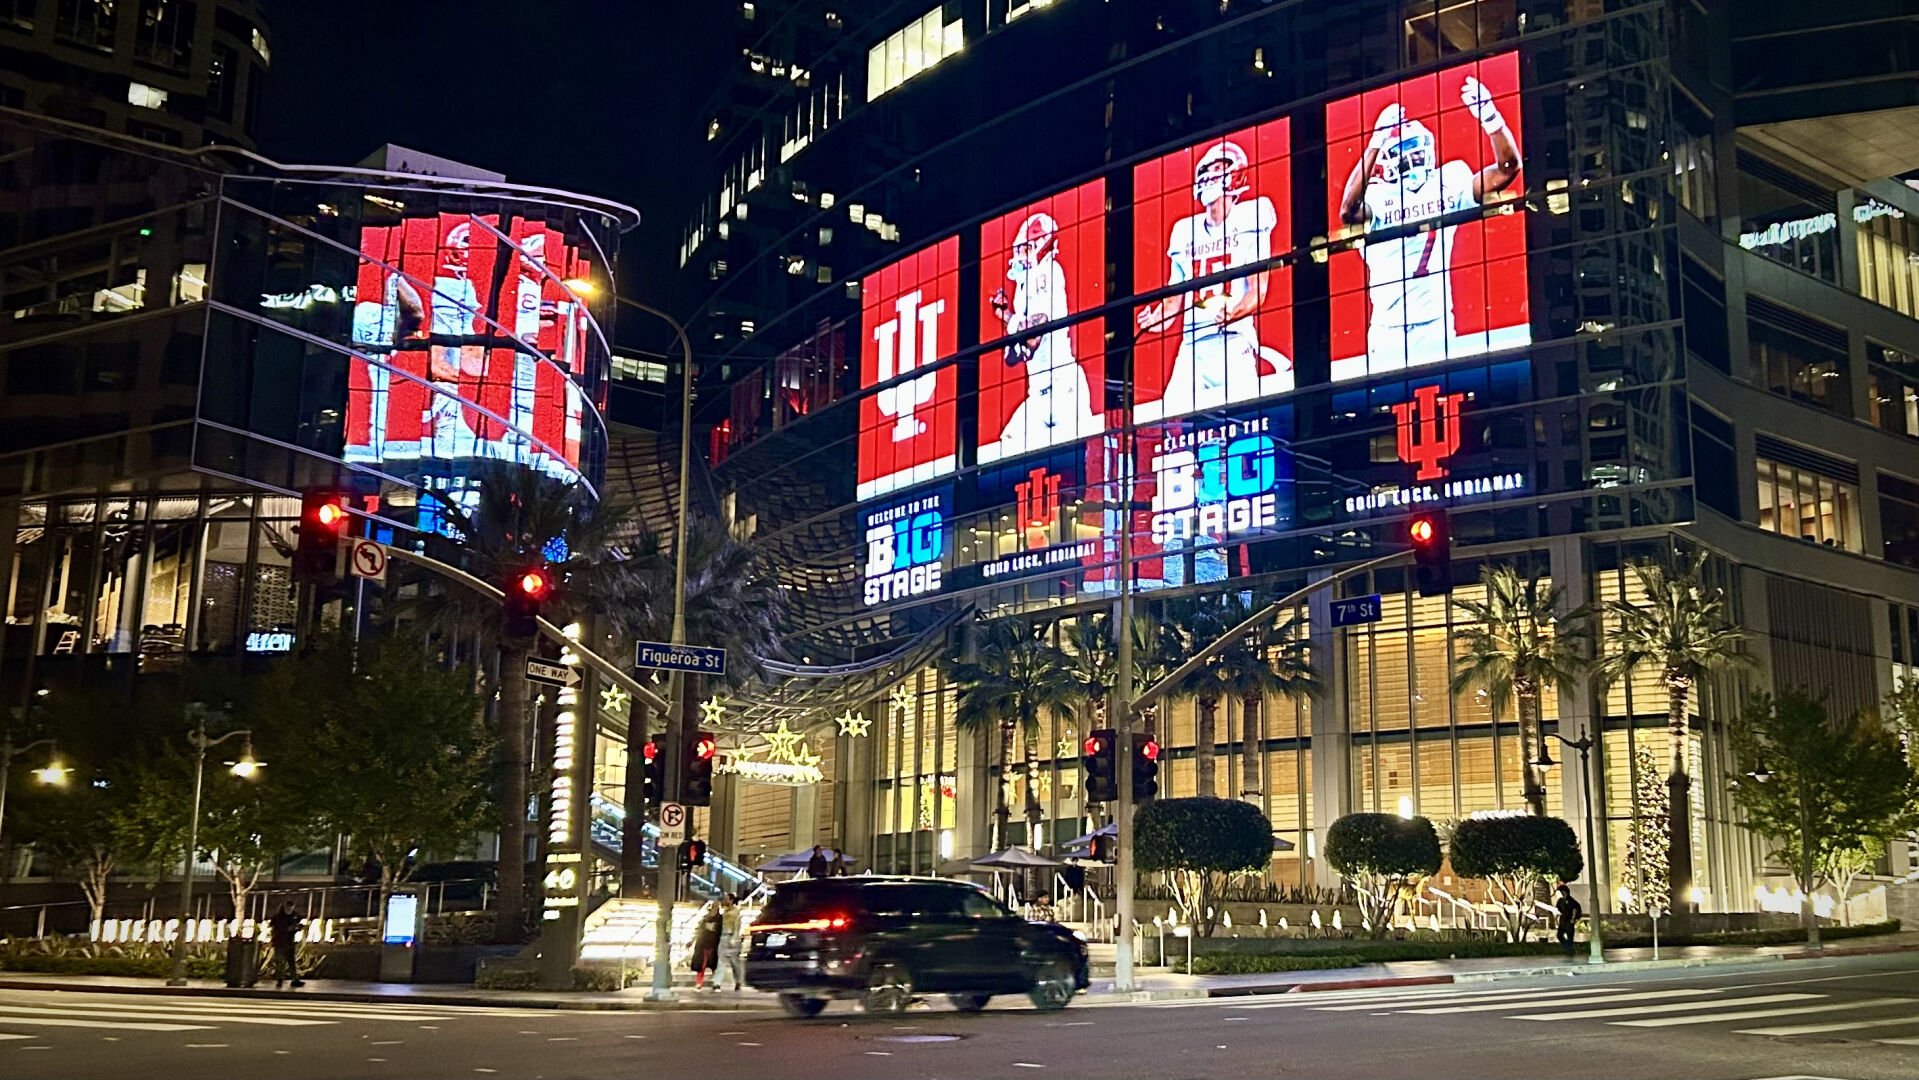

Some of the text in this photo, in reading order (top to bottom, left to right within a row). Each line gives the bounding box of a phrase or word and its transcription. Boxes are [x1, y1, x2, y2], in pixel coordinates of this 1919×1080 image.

[1219, 423, 1237, 439] TO
[1243, 417, 1269, 434] THE
[1346, 493, 1387, 513] GOOD
[1444, 473, 1522, 498] INDIANA!
[867, 495, 940, 527] WELCOME TO THE
[1151, 493, 1276, 544] STAGE
[982, 560, 1010, 577] GOOD
[1044, 542, 1095, 565] INDIANA!
[863, 561, 942, 606] STAGE
[1336, 602, 1374, 622] 7th St
[529, 663, 569, 680] ONE WAY
[642, 648, 700, 666] Figueroa
[705, 654, 721, 668] St
